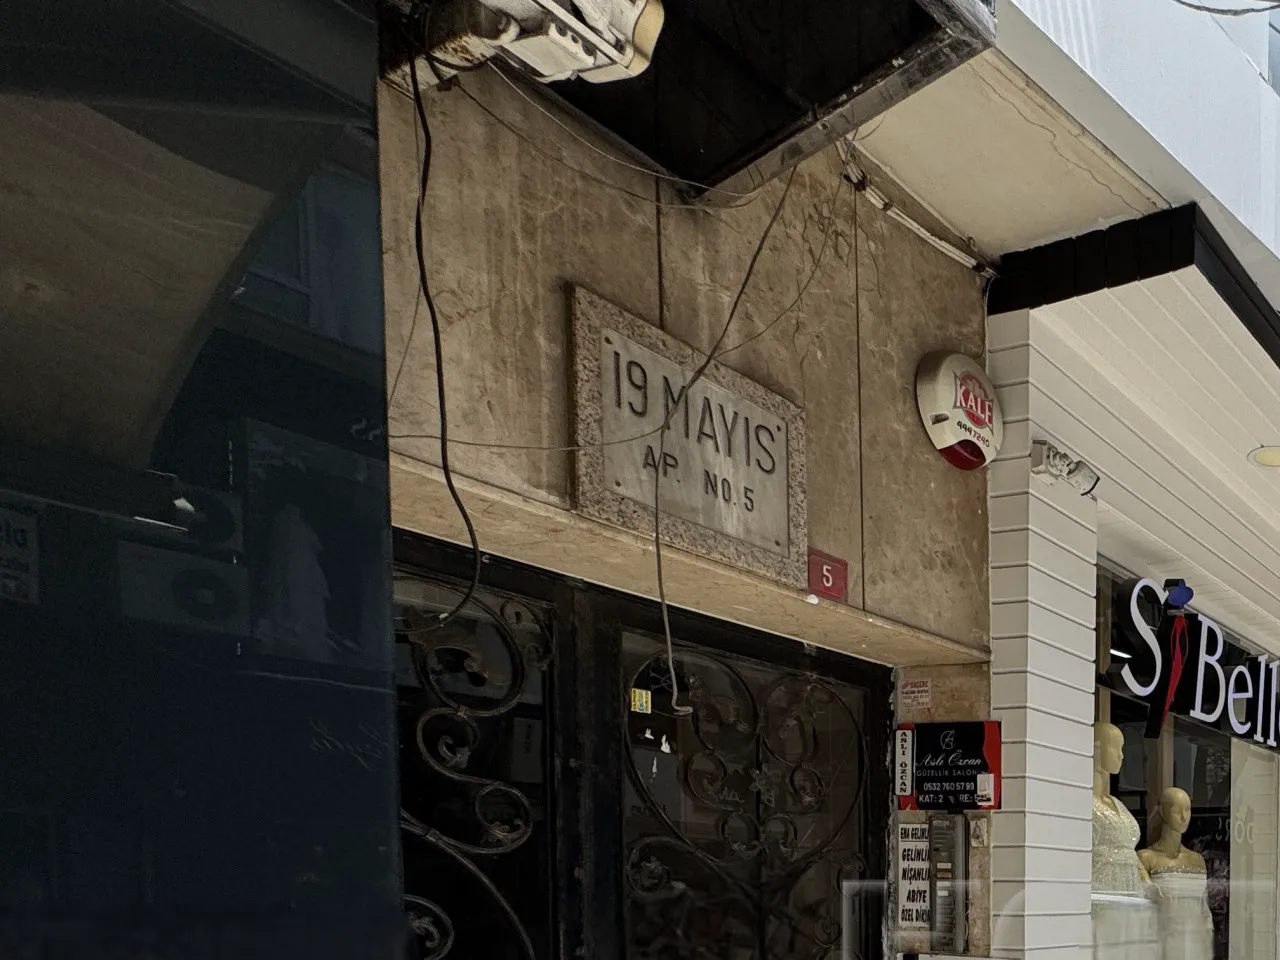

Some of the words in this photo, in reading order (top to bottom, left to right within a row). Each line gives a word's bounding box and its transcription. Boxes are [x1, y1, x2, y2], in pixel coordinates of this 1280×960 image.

[610, 348, 650, 420] 19
[662, 373, 778, 476] MAYIS
[955, 377, 993, 426] KALE
[640, 444, 683, 484] AP.
[702, 469, 738, 507] NO.
[743, 486, 756, 513] 5
[820, 563, 833, 588] 5
[899, 731, 908, 756] ASLI
[899, 761, 908, 793] ÖZCAN
[918, 794, 938, 804] KAT:
[938, 794, 944, 803] 2
[906, 887, 928, 903] ABİYE
[901, 905, 914, 922] ÖZEL
